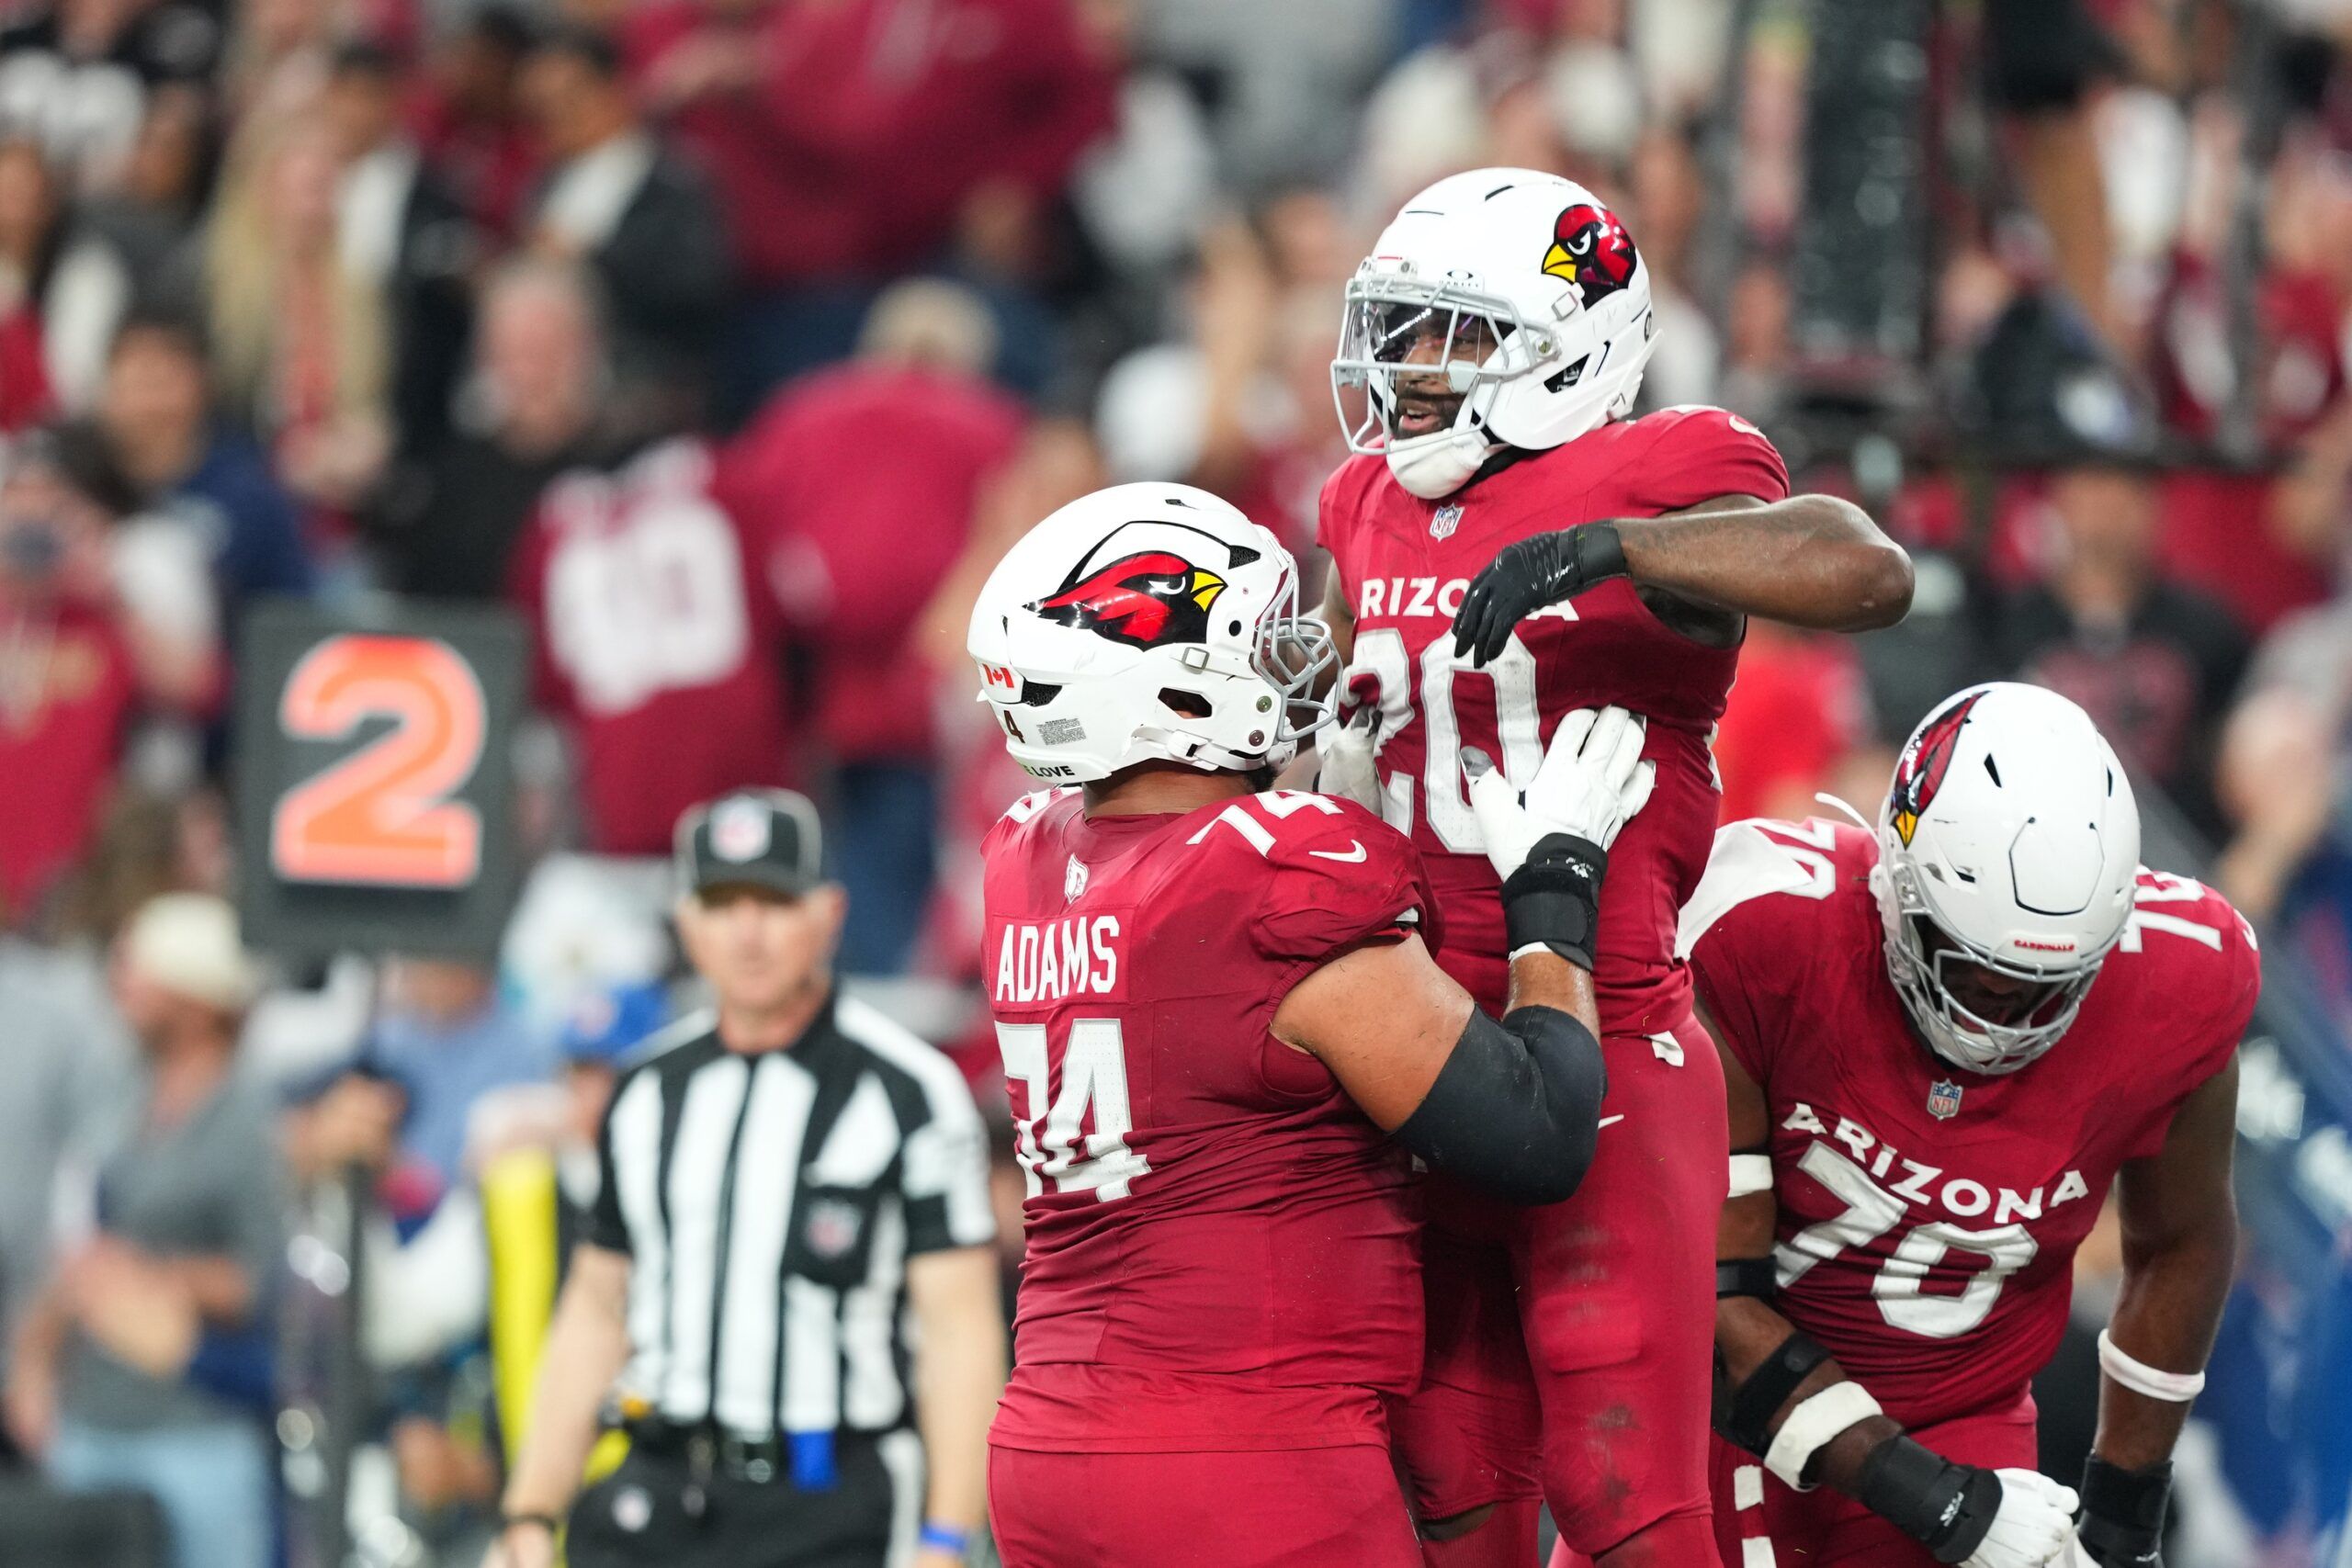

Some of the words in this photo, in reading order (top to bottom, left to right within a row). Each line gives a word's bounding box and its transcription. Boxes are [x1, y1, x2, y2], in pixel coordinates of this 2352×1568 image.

[272, 634, 487, 885] 2
[1031, 765, 1076, 778] LOVE
[1185, 789, 1344, 859] 74
[995, 916, 1120, 1003] ADAMS
[995, 1019, 1152, 1201] 74
[1781, 1102, 2088, 1224] ARIZONA
[1776, 1140, 2039, 1338] 70
